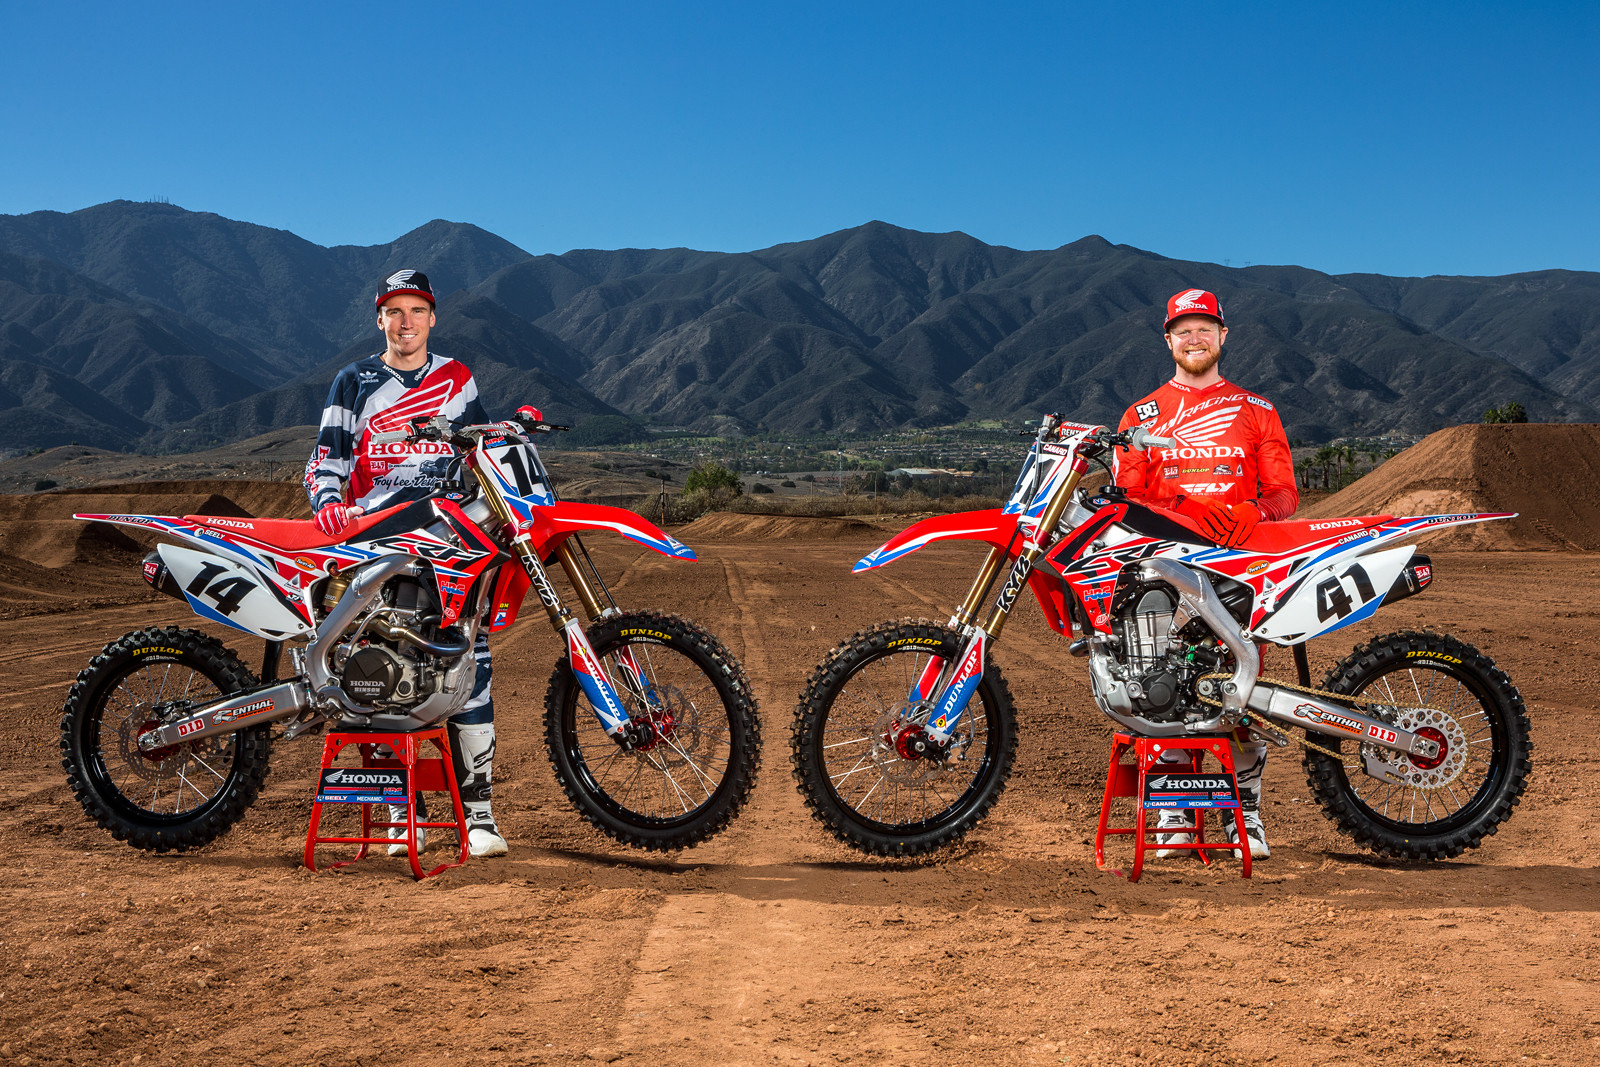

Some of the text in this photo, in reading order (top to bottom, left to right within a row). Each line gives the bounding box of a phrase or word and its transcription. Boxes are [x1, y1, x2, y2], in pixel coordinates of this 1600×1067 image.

[386, 283, 420, 292] HONDA
[1175, 303, 1208, 313] HONDA
[369, 442, 453, 456] HONDA
[1043, 444, 1068, 456] CANARD
[1160, 446, 1245, 462] HONDA
[393, 475, 411, 487] Lee
[1180, 482, 1235, 494] FLY
[108, 515, 154, 525] DUNLOP
[206, 517, 255, 530] HONDA
[1309, 519, 1364, 531] HONDA
[1427, 514, 1478, 524] DUNLOP
[204, 528, 226, 540] SEELY
[1338, 530, 1368, 545] CANARD
[186, 561, 258, 617] 14
[440, 580, 466, 596] HRC
[996, 555, 1031, 613] KYB
[1083, 585, 1111, 602] HRC
[1316, 562, 1377, 624] 41
[620, 628, 672, 640] DUNLOP
[887, 637, 942, 648] DUNLOP
[132, 646, 184, 657] DUNLOP
[1405, 650, 1462, 664] DUNLOP
[943, 650, 977, 714] DUNLOP
[588, 661, 621, 717] DUNLOP
[340, 774, 403, 784] HONDA
[1166, 779, 1231, 789] HONDA
